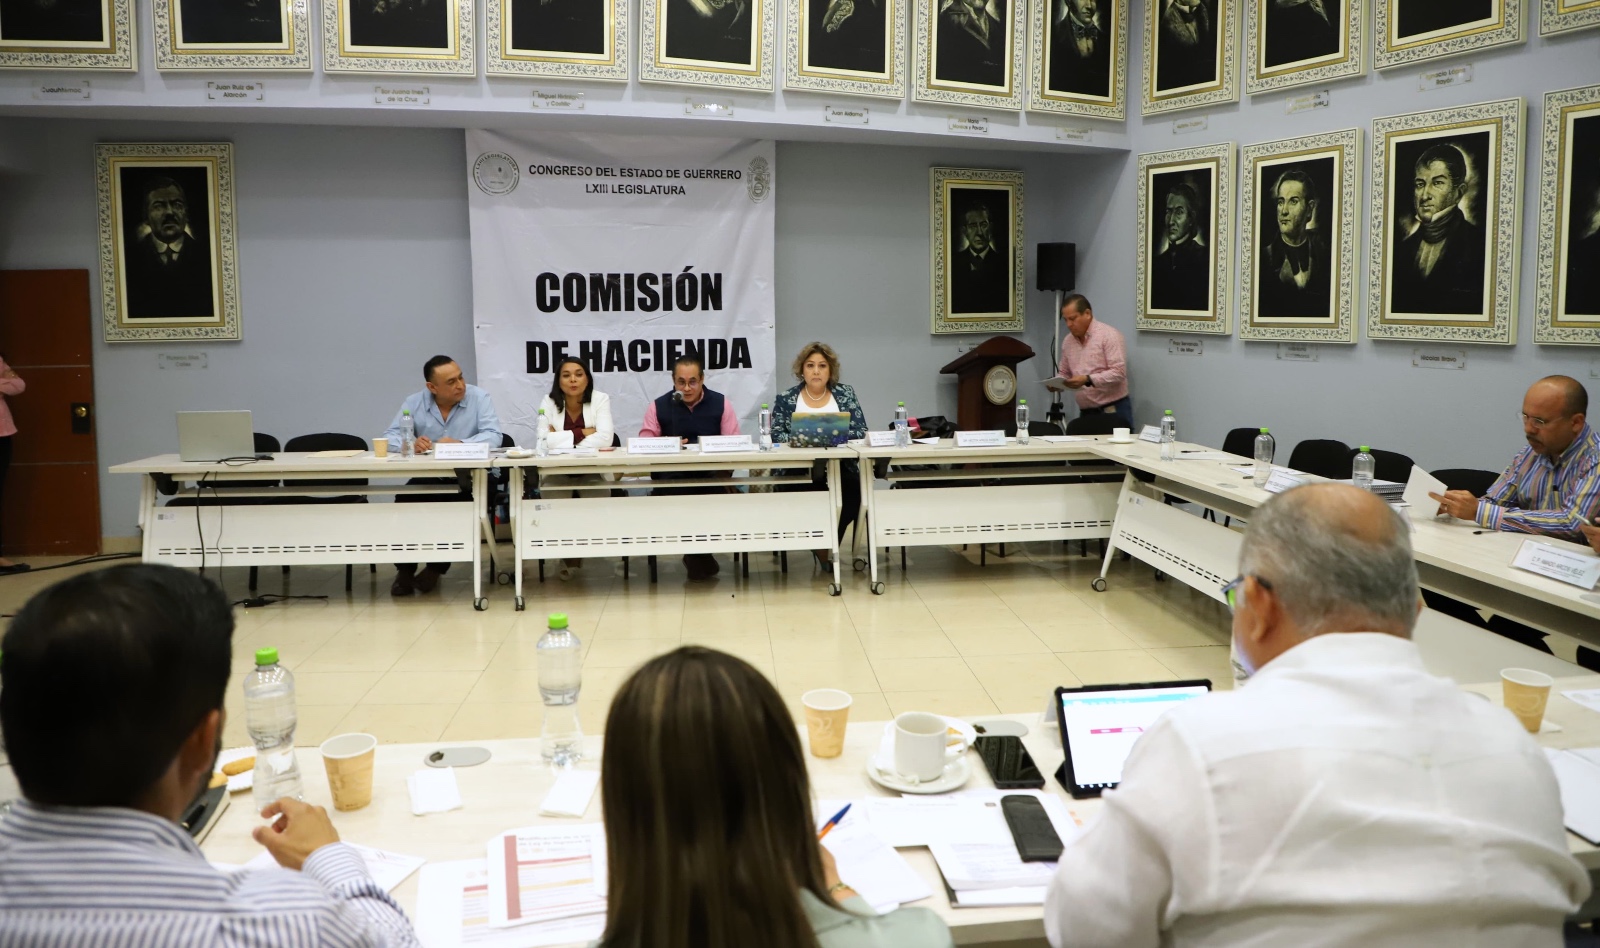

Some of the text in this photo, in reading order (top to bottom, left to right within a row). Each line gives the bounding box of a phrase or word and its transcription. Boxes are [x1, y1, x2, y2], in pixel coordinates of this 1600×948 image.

[528, 164, 742, 180] CONGRESO DEL ESTADO DE GUERRERO
[585, 183, 686, 196] LXIII LEGISLATURA
[535, 265, 722, 313] COMISIÓN
[526, 337, 753, 373] DE HACIENDA
